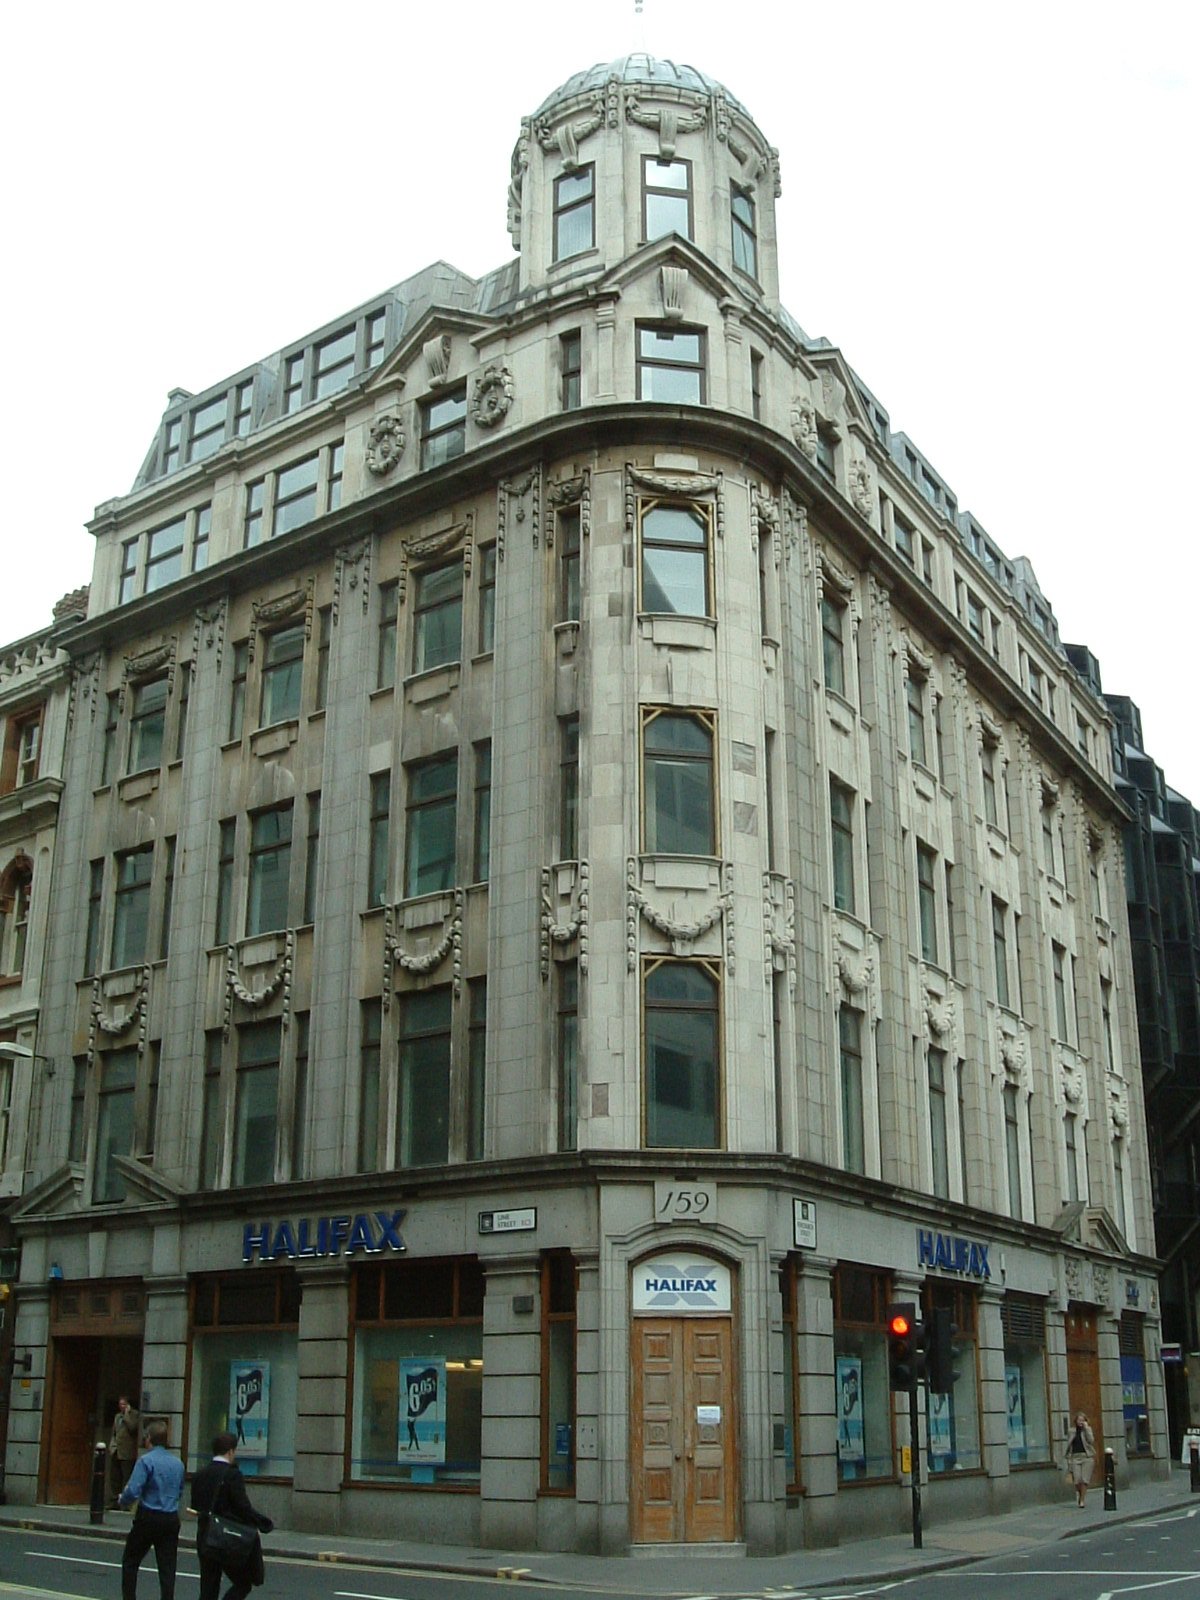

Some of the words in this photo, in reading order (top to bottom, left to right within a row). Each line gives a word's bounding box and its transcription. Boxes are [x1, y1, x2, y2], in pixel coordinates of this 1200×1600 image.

[659, 1191, 710, 1214] 159
[242, 1209, 408, 1262] HALIFAX
[916, 1228, 992, 1279] HALIFAX
[645, 1279, 718, 1292] HALIFAX
